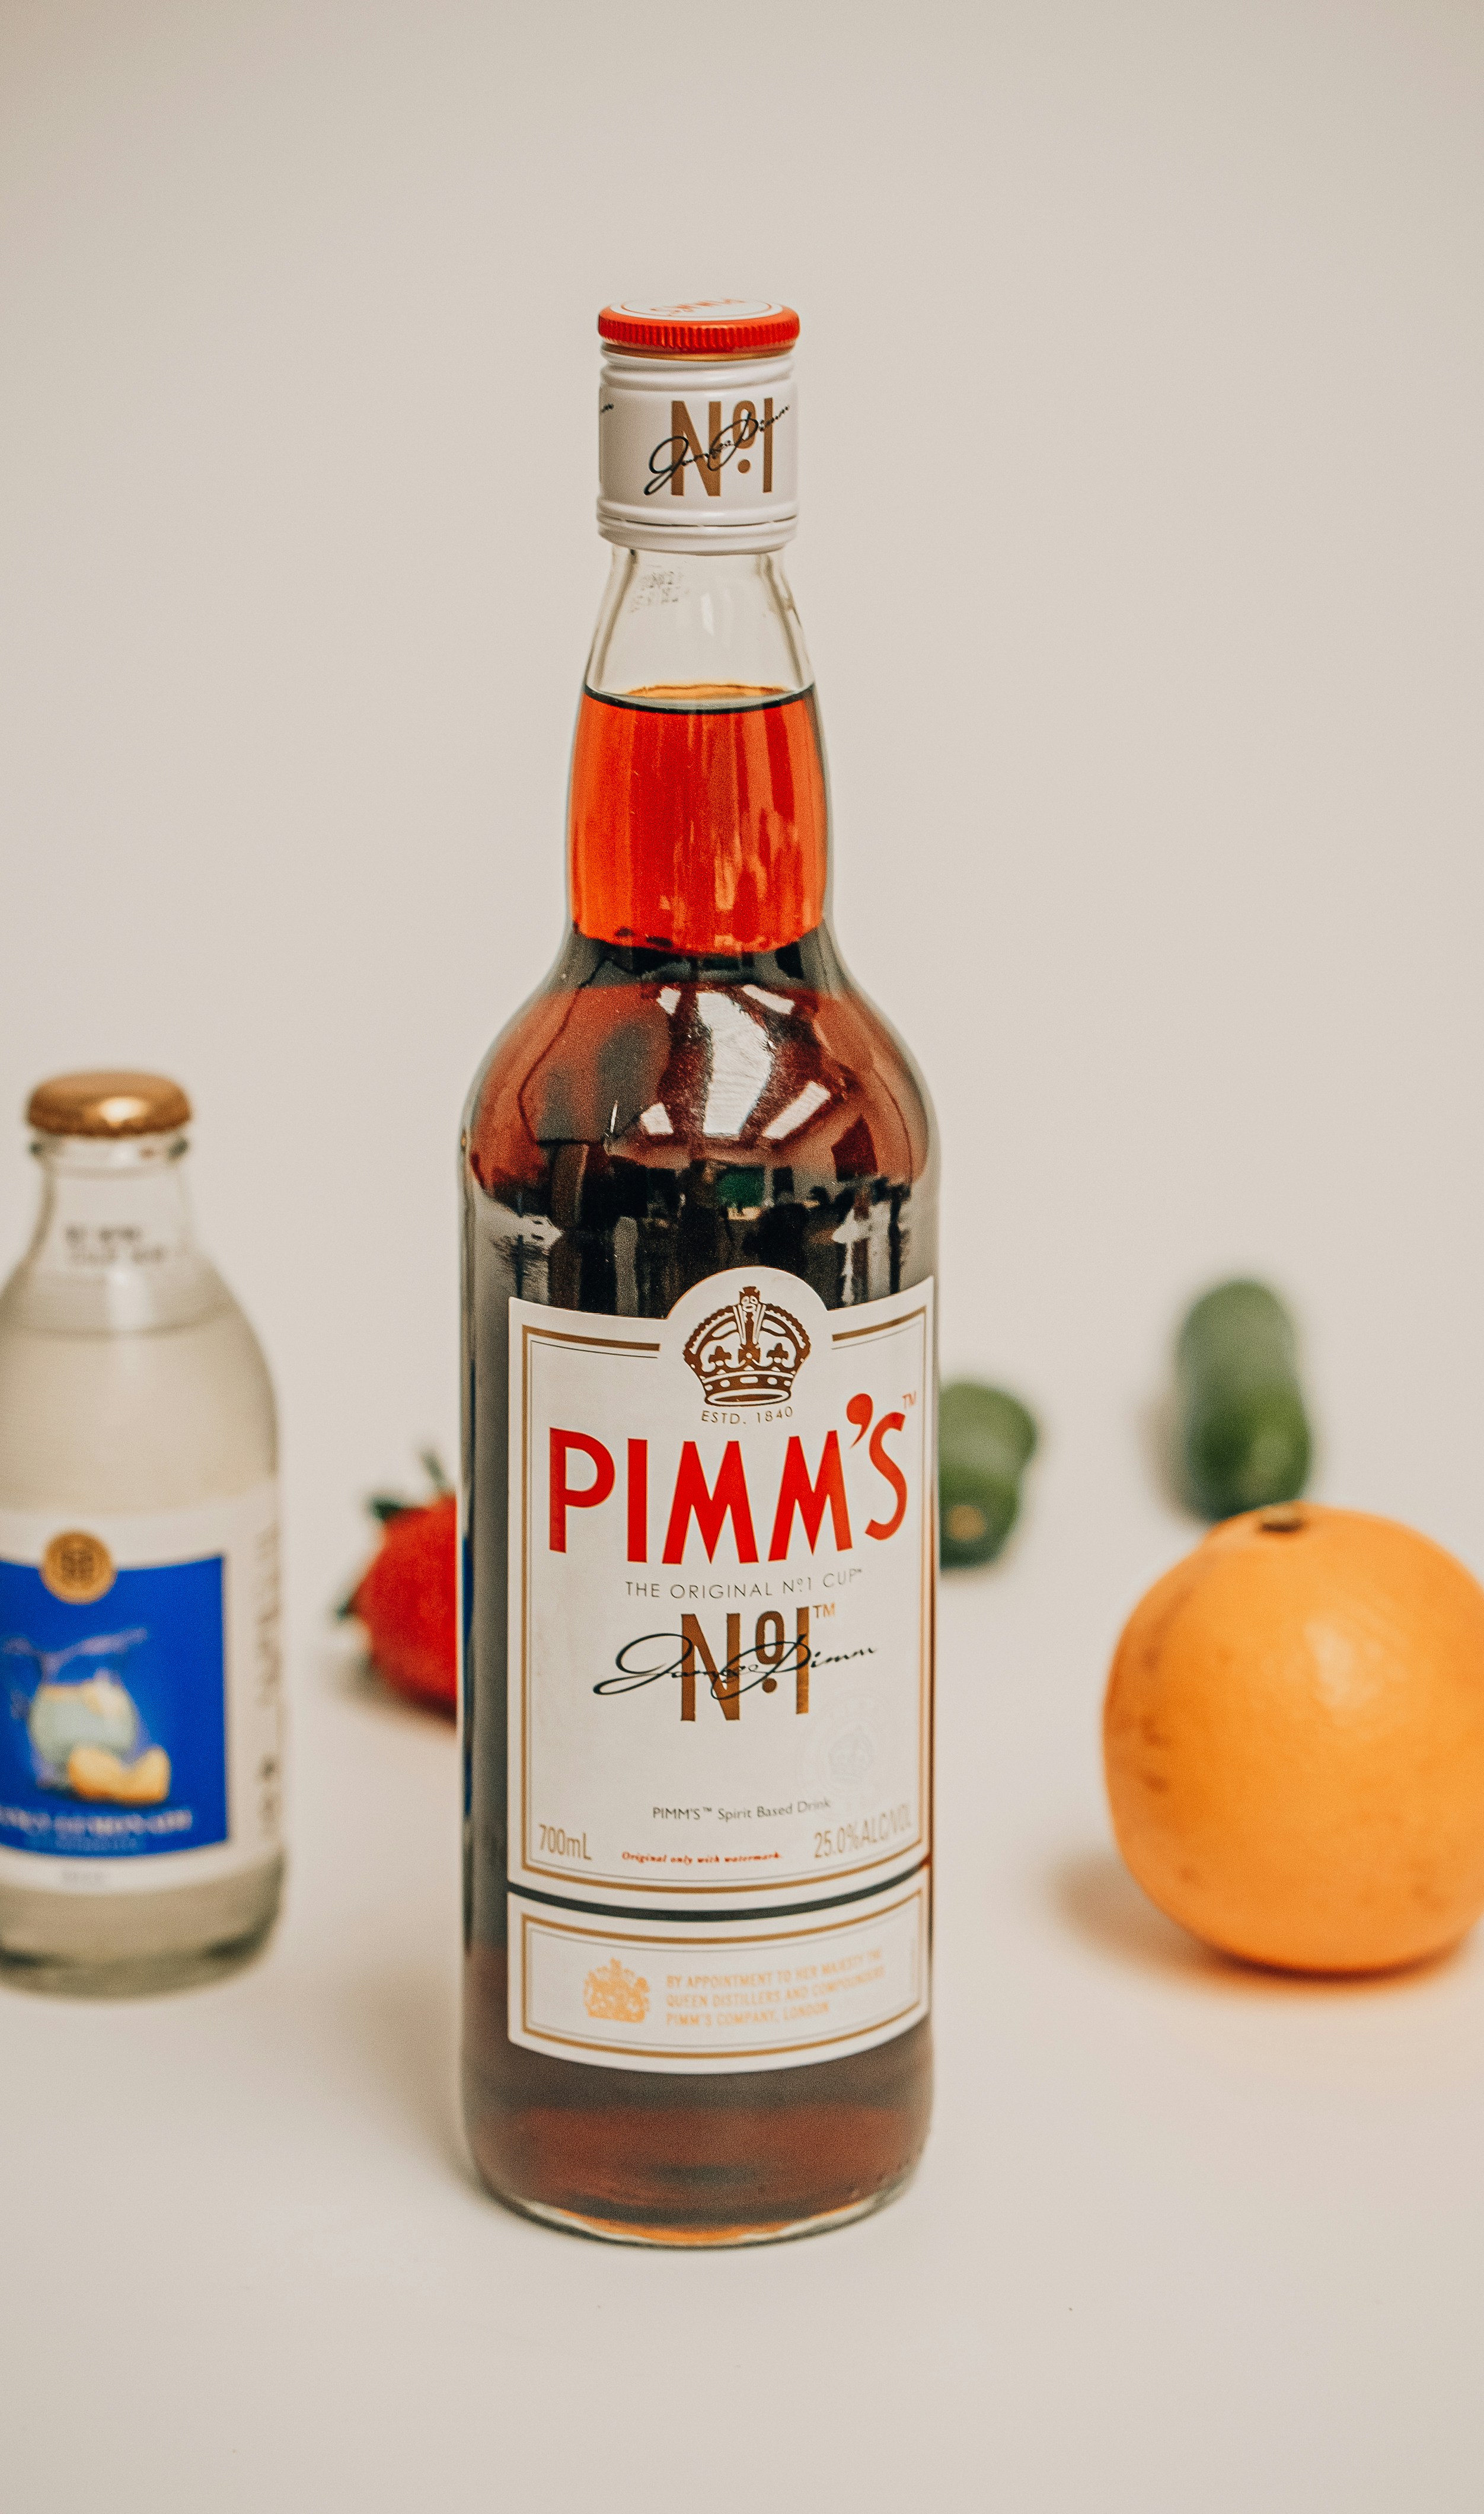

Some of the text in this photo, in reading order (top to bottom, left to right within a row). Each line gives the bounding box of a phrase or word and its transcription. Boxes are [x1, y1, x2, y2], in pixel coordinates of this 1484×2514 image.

[701, 1406, 793, 1424] ESTD. 1840
[549, 1393, 907, 1565] PIMM'S
[625, 1581, 660, 1597] THE
[670, 1582, 773, 1599] ORIGINAL
[718, 1808, 752, 1823] Spirit
[757, 1803, 793, 1818] Based
[797, 1797, 831, 1813] Drink
[538, 1822, 592, 1861] 700mL
[622, 1851, 667, 1864] Original
[671, 1855, 692, 1866] only
[697, 1855, 720, 1864] with
[666, 1975, 681, 1988] BY
[687, 1971, 772, 1988] APPOINTMENT
[777, 1969, 792, 1983] TO
[796, 1966, 818, 1980] HER
[822, 1954, 864, 1975] MAJESTY
[666, 1993, 708, 2008] QUEEN
[713, 1990, 780, 2008] DISTILLERS
[786, 1986, 809, 2001] AND
[666, 2012, 712, 2027] PIMM'S
[783, 2002, 829, 2022] LONDON
